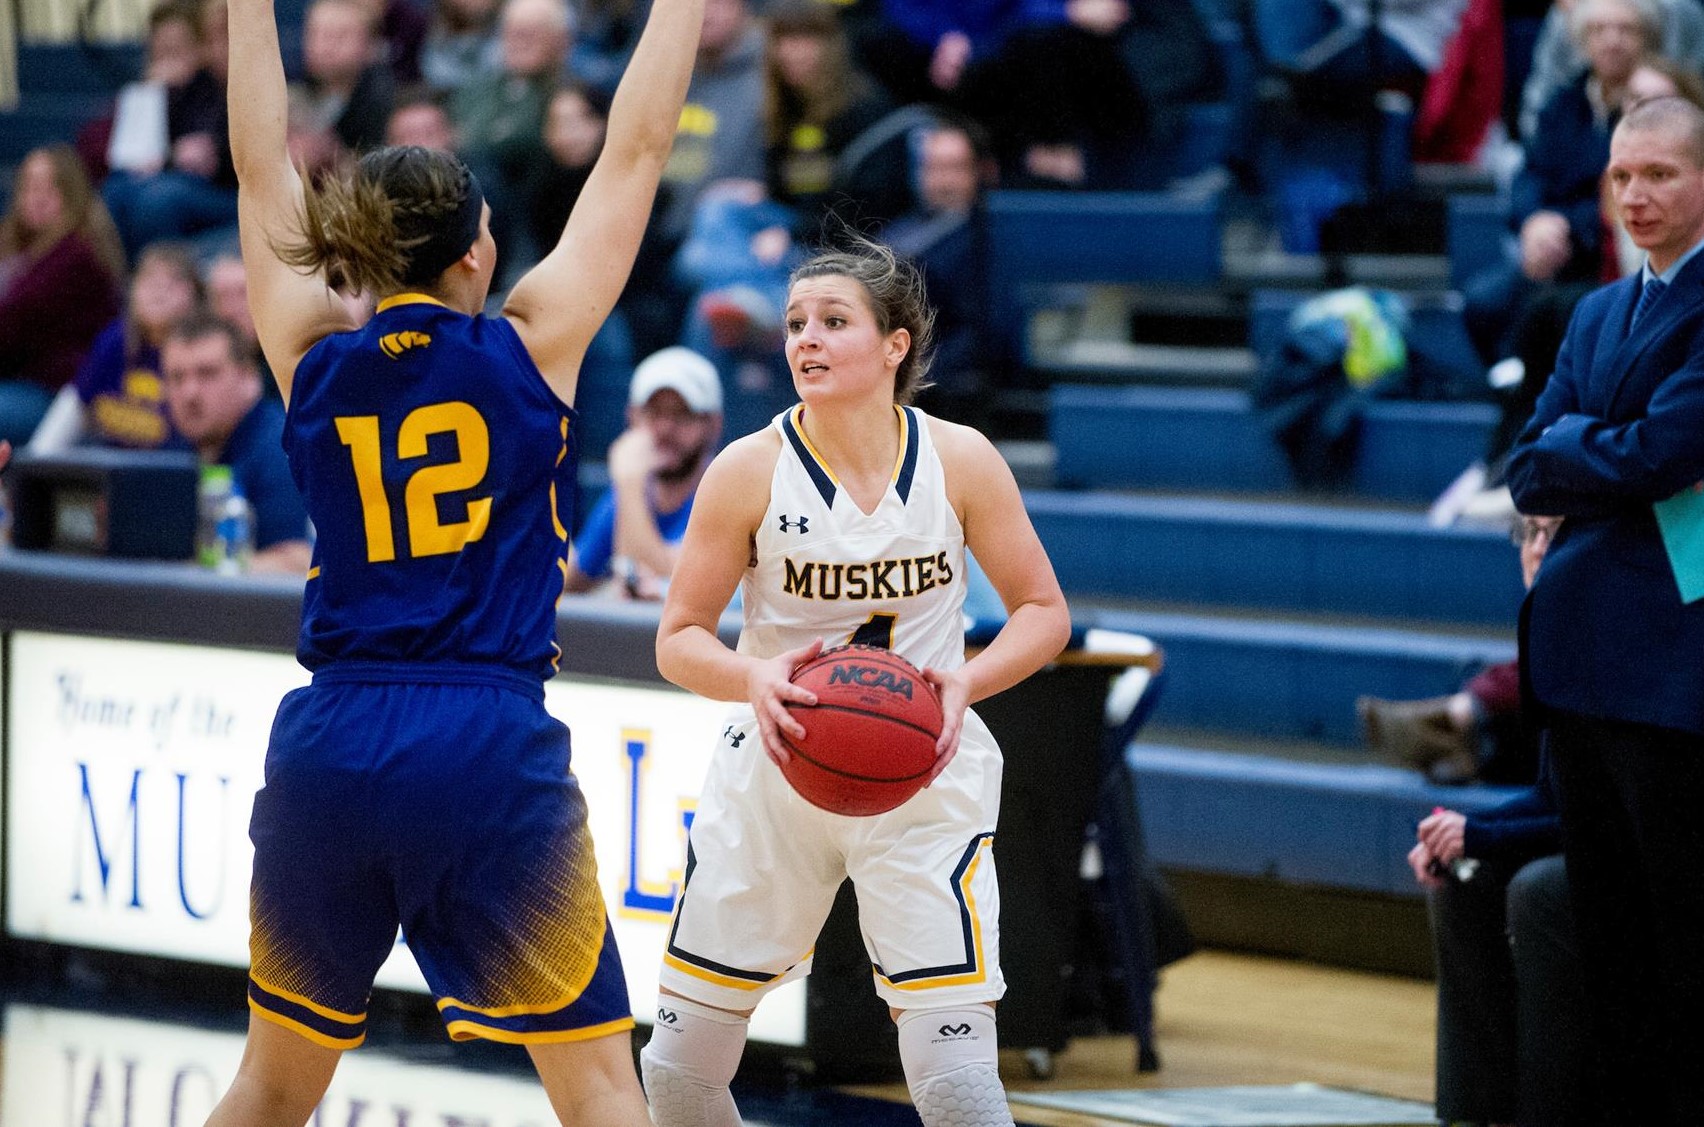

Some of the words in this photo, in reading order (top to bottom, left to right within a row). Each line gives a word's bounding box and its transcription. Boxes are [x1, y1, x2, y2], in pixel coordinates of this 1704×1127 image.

[334, 401, 493, 563] 12
[782, 551, 954, 601] MUSKIES
[827, 664, 914, 702] NCAA
[618, 727, 699, 924] L
